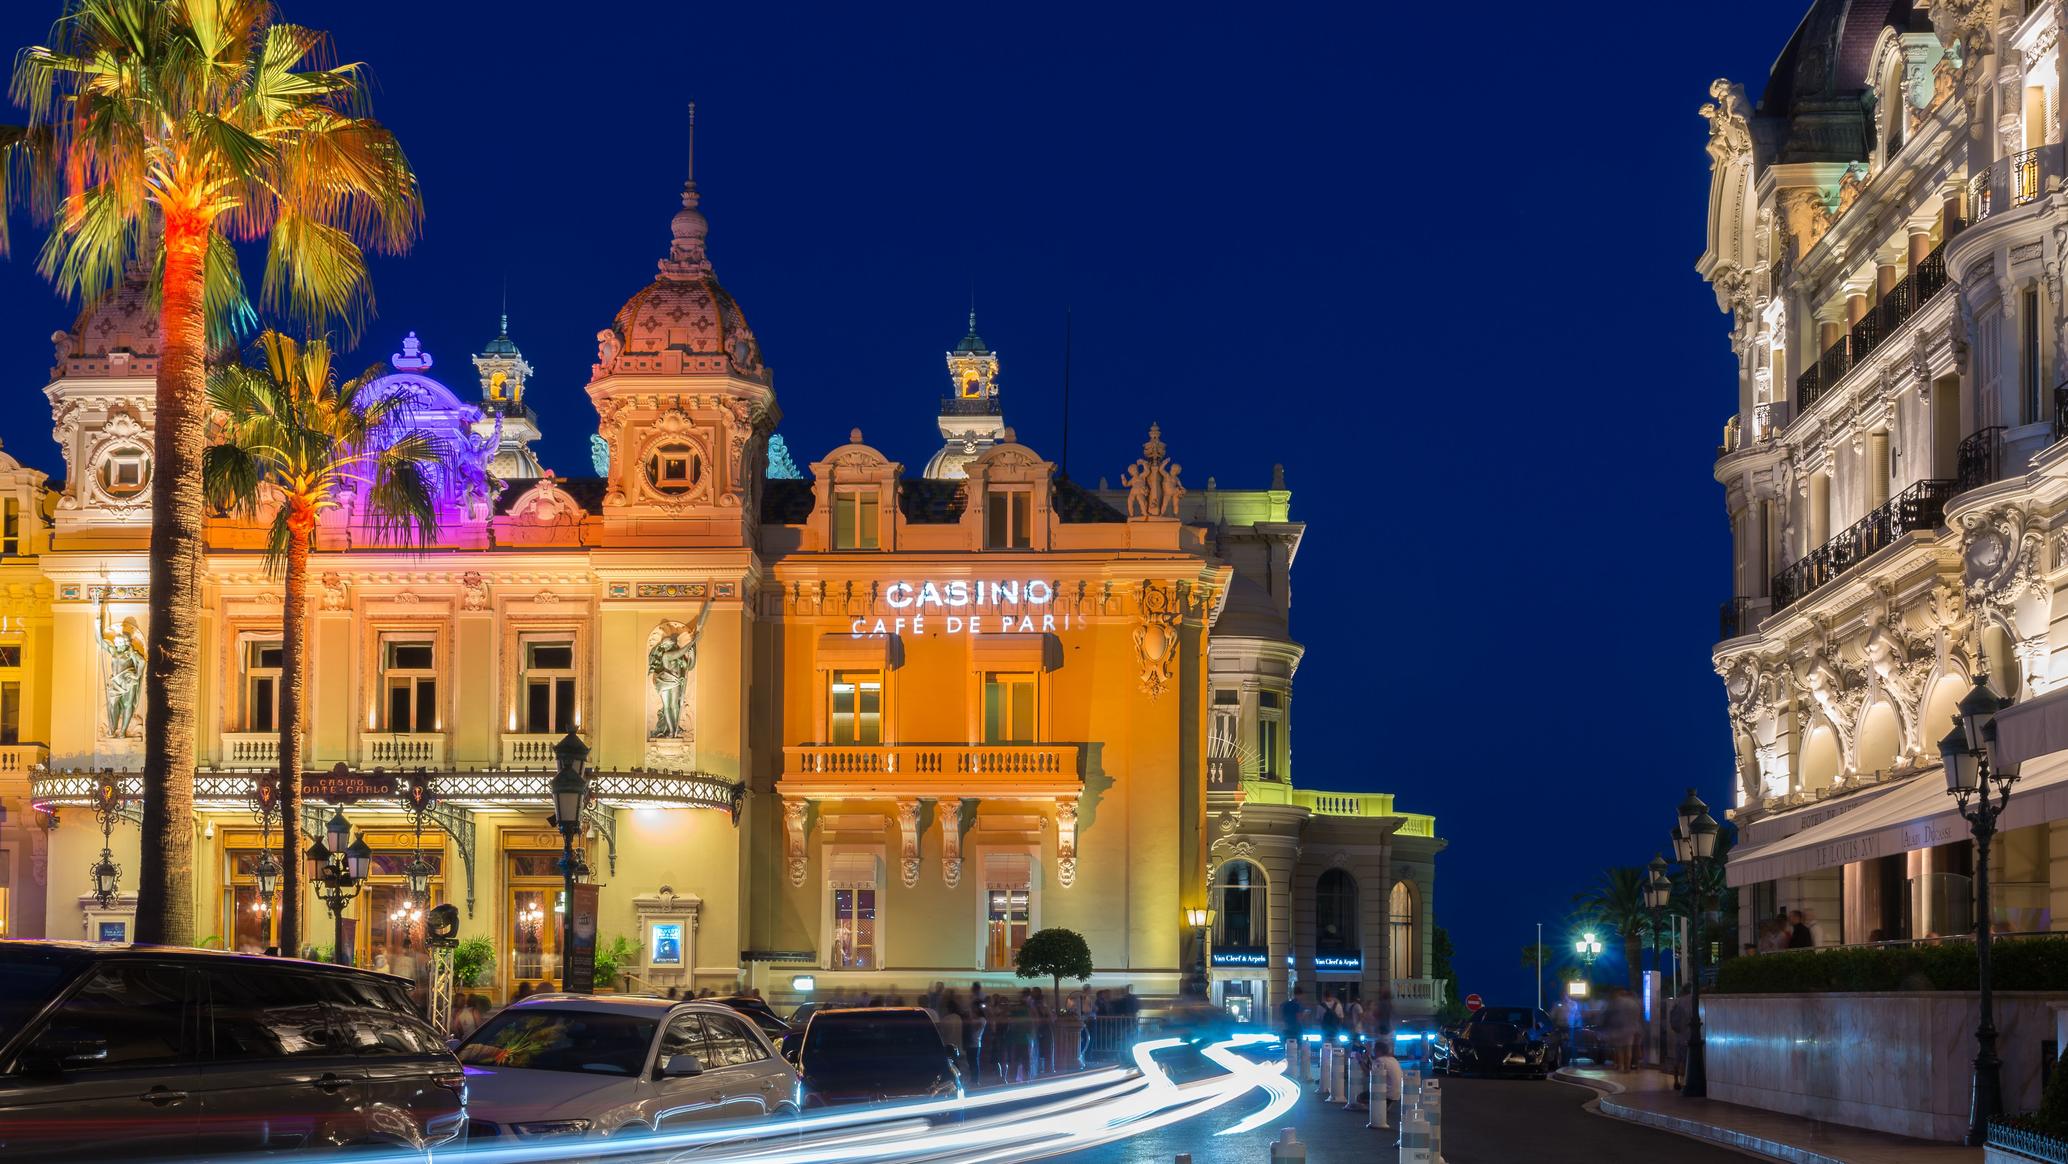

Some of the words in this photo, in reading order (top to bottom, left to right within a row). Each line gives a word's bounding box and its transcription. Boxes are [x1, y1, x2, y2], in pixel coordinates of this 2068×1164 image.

[886, 579, 1053, 609] CASINO
[851, 613, 925, 639] CAFÉ
[946, 616, 982, 633] DE
[1002, 613, 1088, 634] PARIS
[303, 785, 389, 794] ONTE-CARLO
[1816, 847, 1827, 866] LE
[1830, 840, 1858, 863] LOUIS
[1860, 836, 1875, 857] XV
[1214, 954, 1225, 962] Van
[1226, 954, 1242, 962] Cleef
[1248, 955, 1266, 964] Arpels
[1315, 957, 1325, 965] Van
